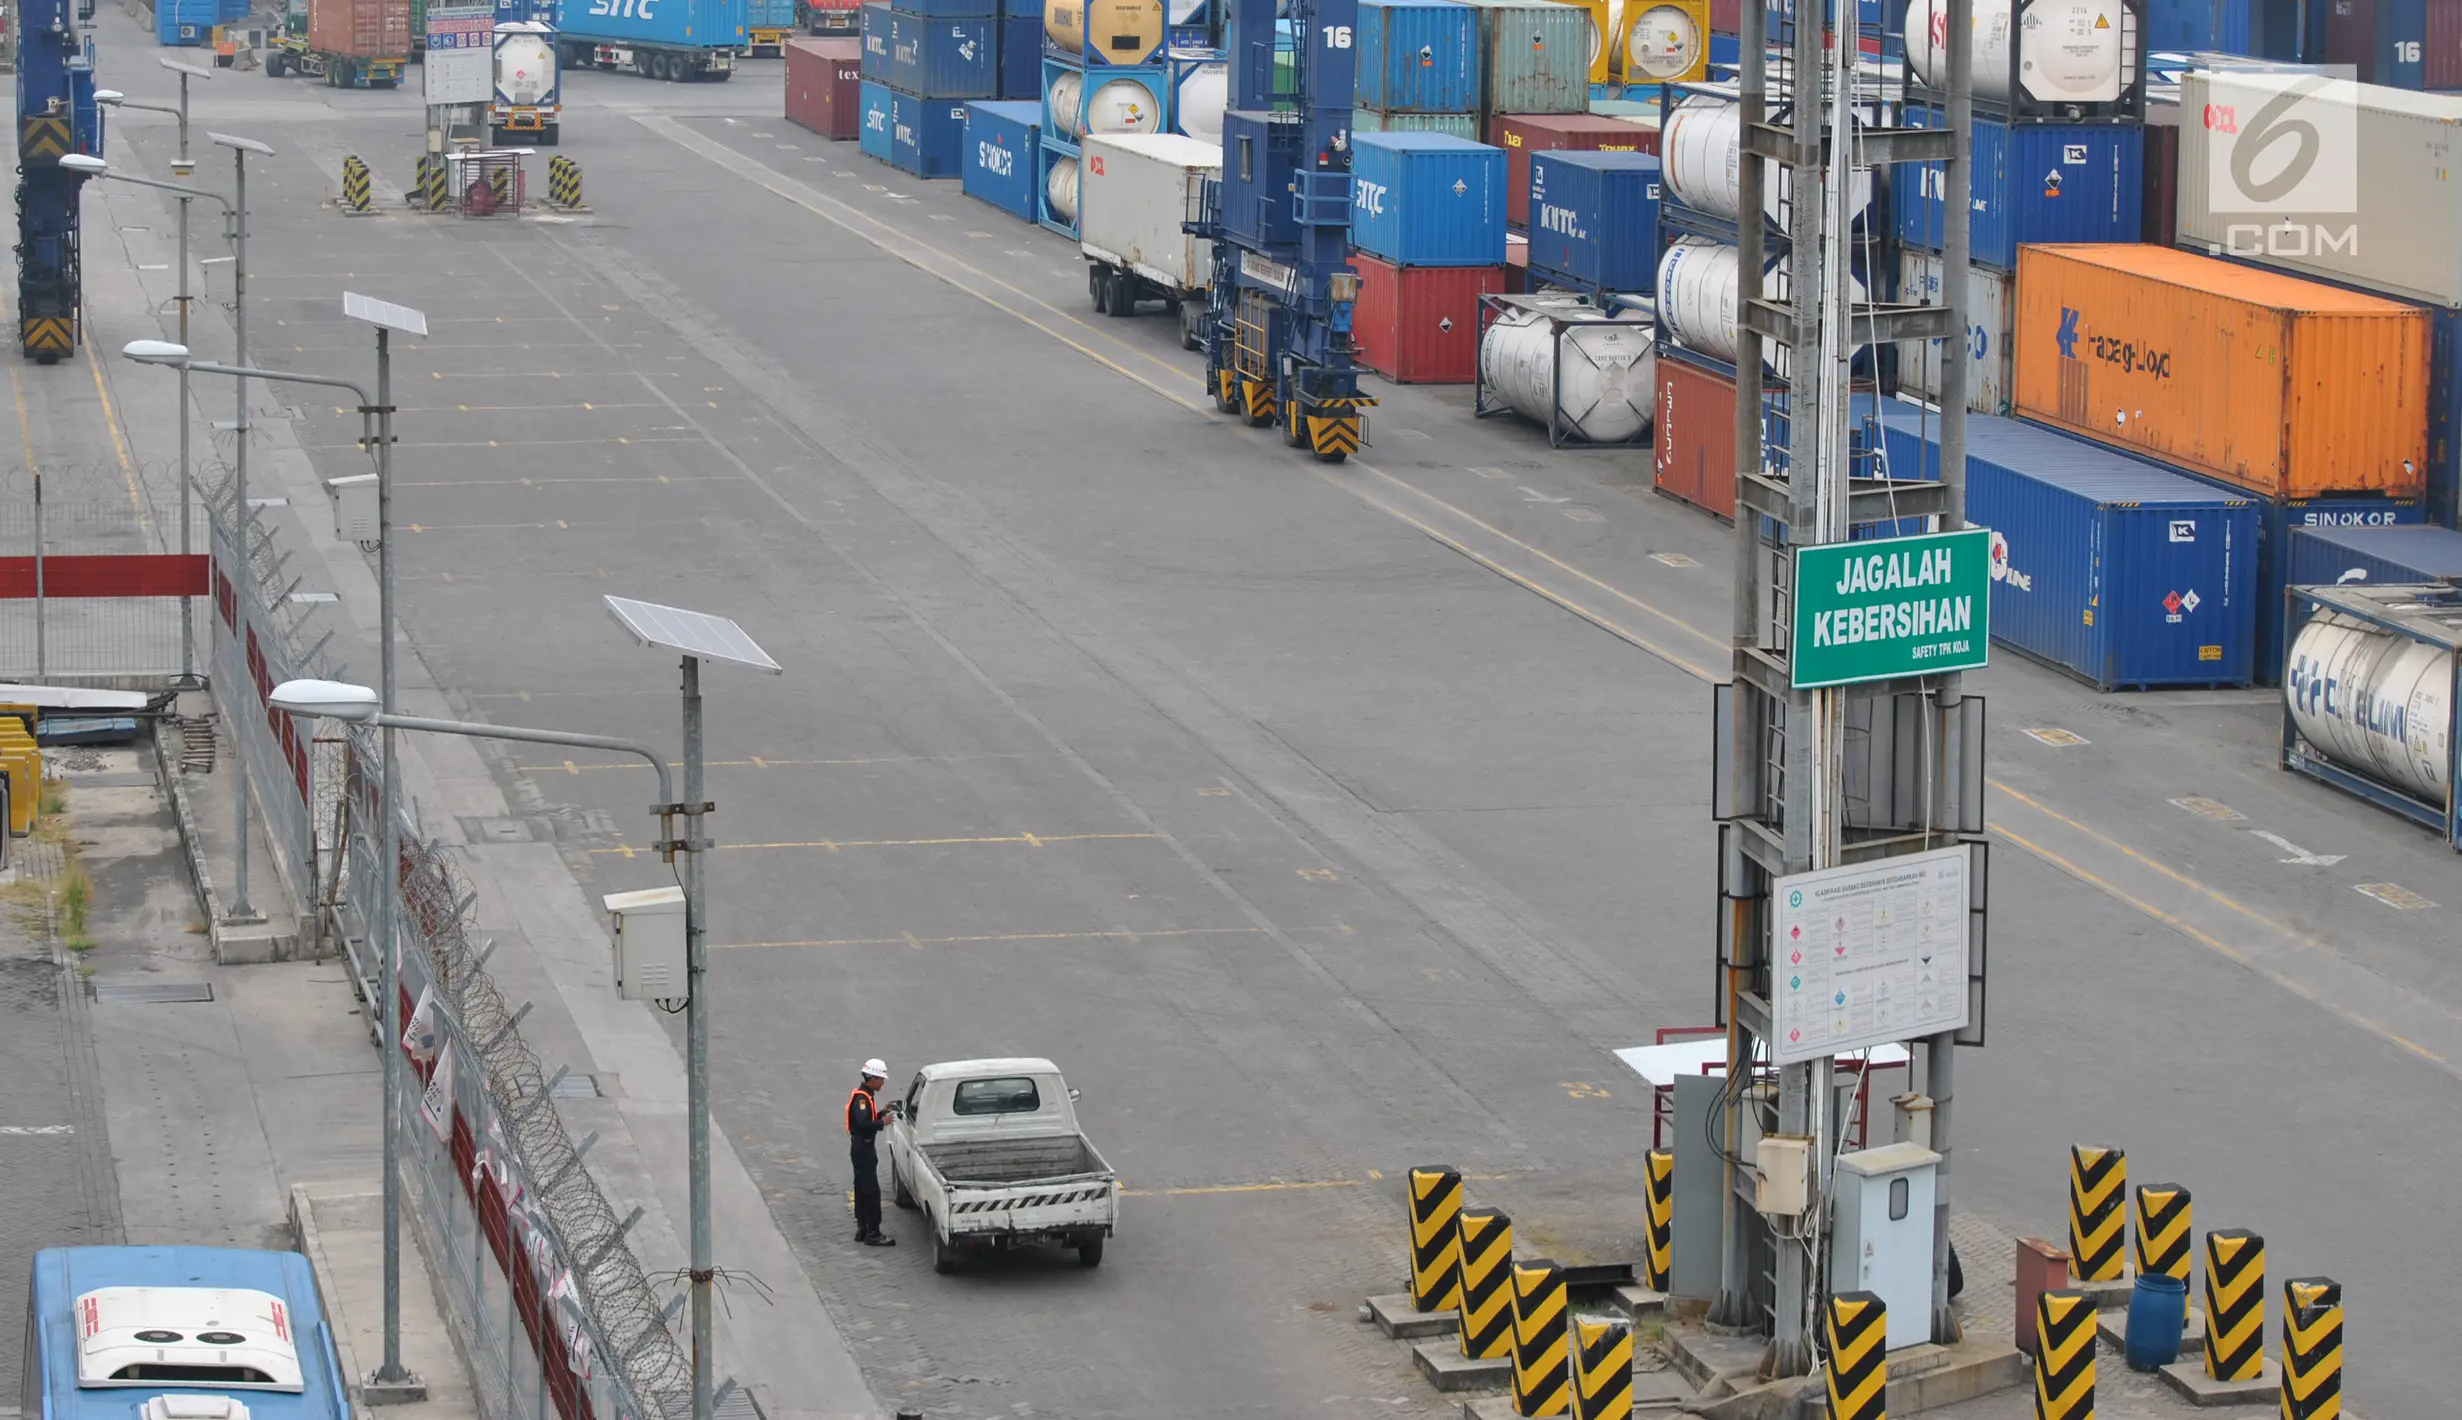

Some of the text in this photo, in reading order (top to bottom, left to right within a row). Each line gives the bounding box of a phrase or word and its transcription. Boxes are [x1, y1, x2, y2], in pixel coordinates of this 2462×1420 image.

[1322, 25, 1351, 49] 16
[2394, 41, 2421, 63] 16
[2303, 511, 2397, 527] SINOKOR
[1836, 547, 1952, 595] JAGALAH
[2006, 566, 2032, 593] LINE
[1813, 595, 1972, 648] KEBERSIHAN
[1912, 639, 1970, 660] SAFETY TPK KOJA
